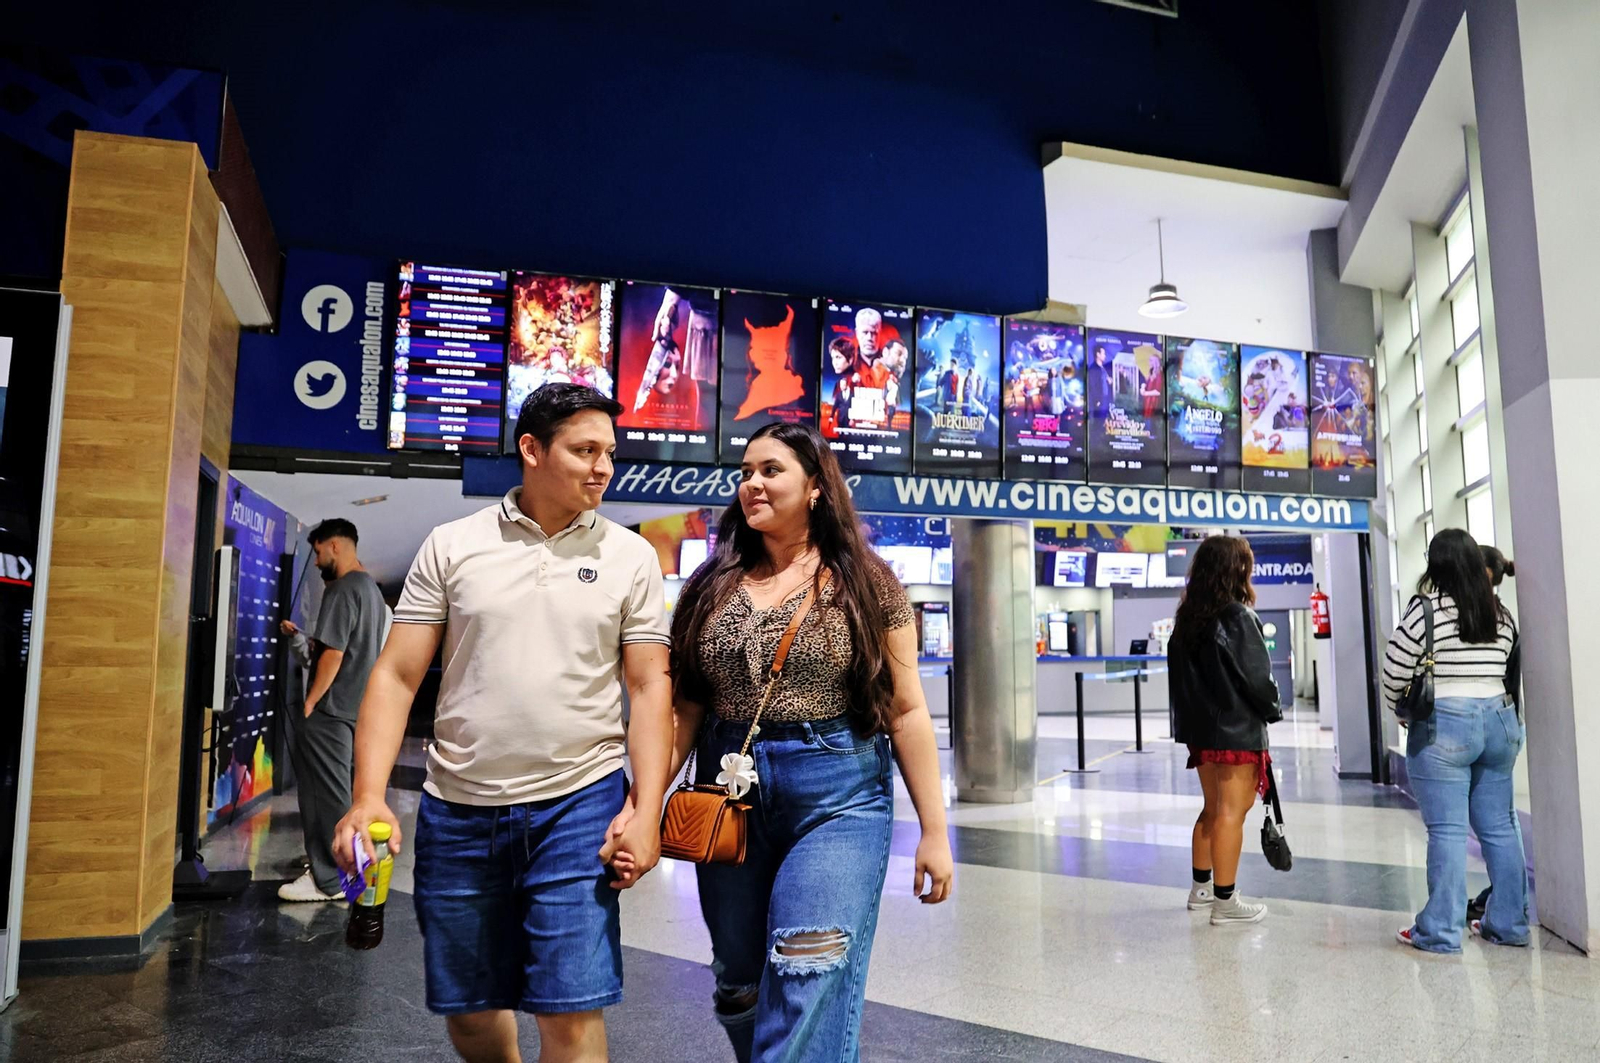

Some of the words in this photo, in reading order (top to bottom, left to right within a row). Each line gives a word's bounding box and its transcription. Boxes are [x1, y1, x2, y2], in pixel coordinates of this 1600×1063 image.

[356, 281, 385, 431] cinesaqualon.com
[1184, 405, 1223, 423] ANGELO
[615, 464, 743, 498] HAGAS
[231, 500, 264, 535] AQUALON
[893, 476, 1353, 526] www.cinesaqualon.com
[924, 517, 952, 535] CI
[1251, 562, 1314, 577] ENTRADA
